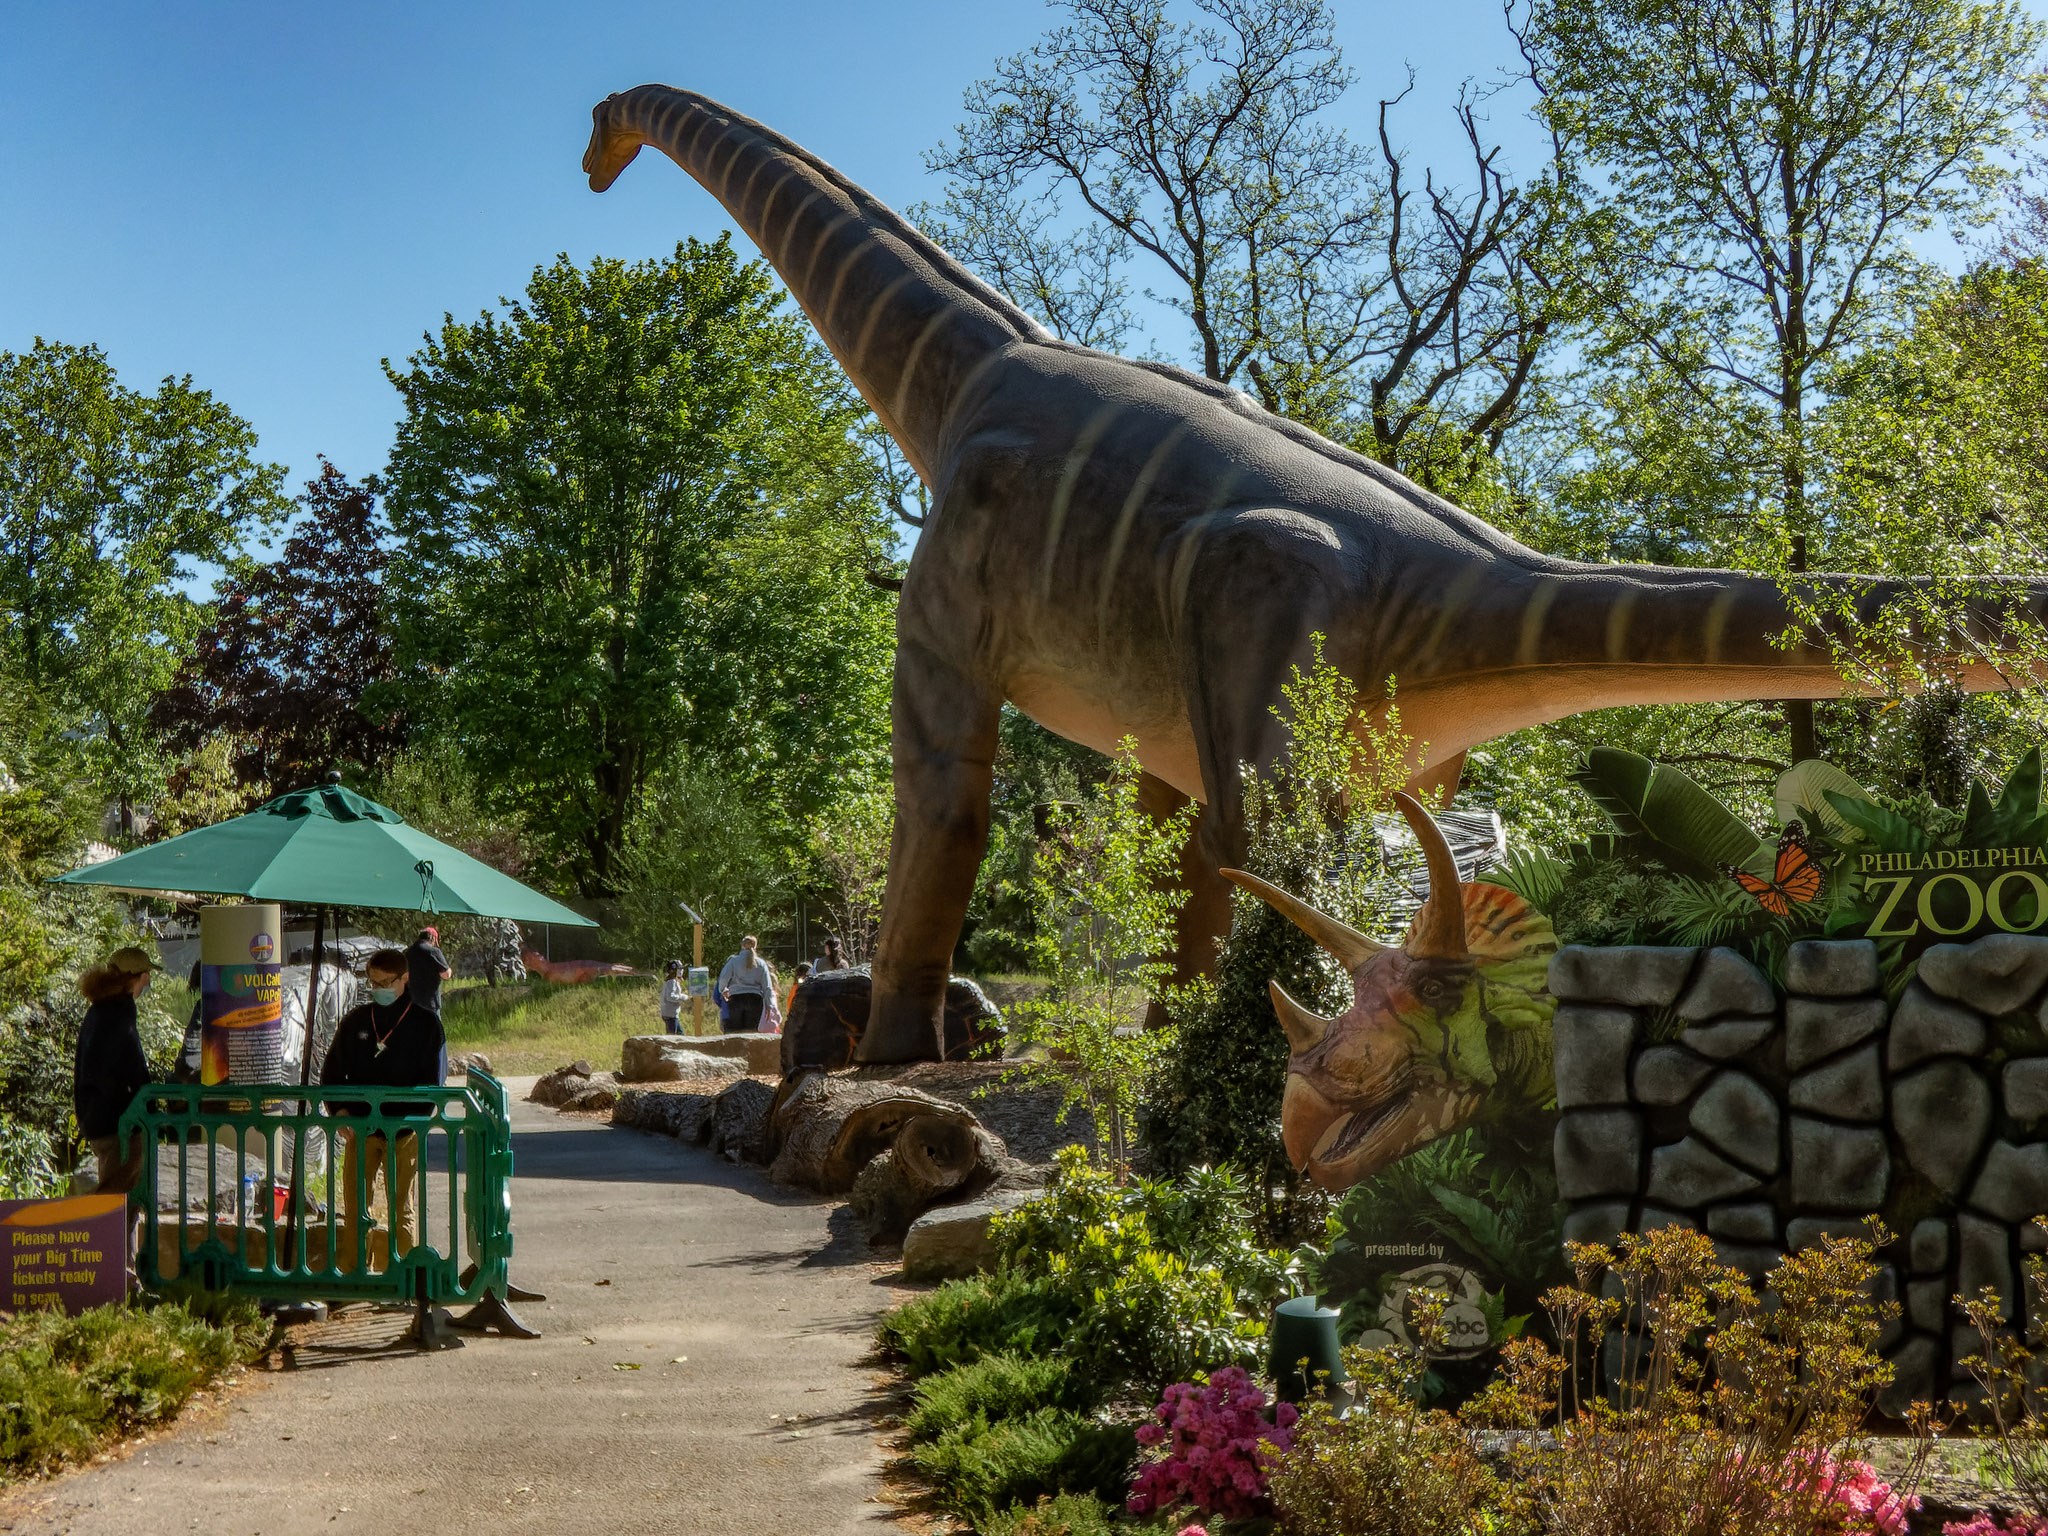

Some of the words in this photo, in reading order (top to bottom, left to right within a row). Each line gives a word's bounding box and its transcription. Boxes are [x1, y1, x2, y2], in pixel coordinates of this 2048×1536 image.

[1859, 846, 2048, 872] PHILADELPHIA
[1863, 870, 2048, 937] ZOO
[12, 1231, 56, 1247] Please
[59, 1230, 90, 1244] have
[13, 1252, 42, 1269] your
[46, 1249, 66, 1267] Big
[70, 1248, 103, 1263] Time
[1365, 1243, 1426, 1258] presented
[1429, 1243, 1444, 1259] by
[12, 1270, 56, 1285] tickets
[60, 1268, 96, 1286] ready
[12, 1292, 26, 1306] to
